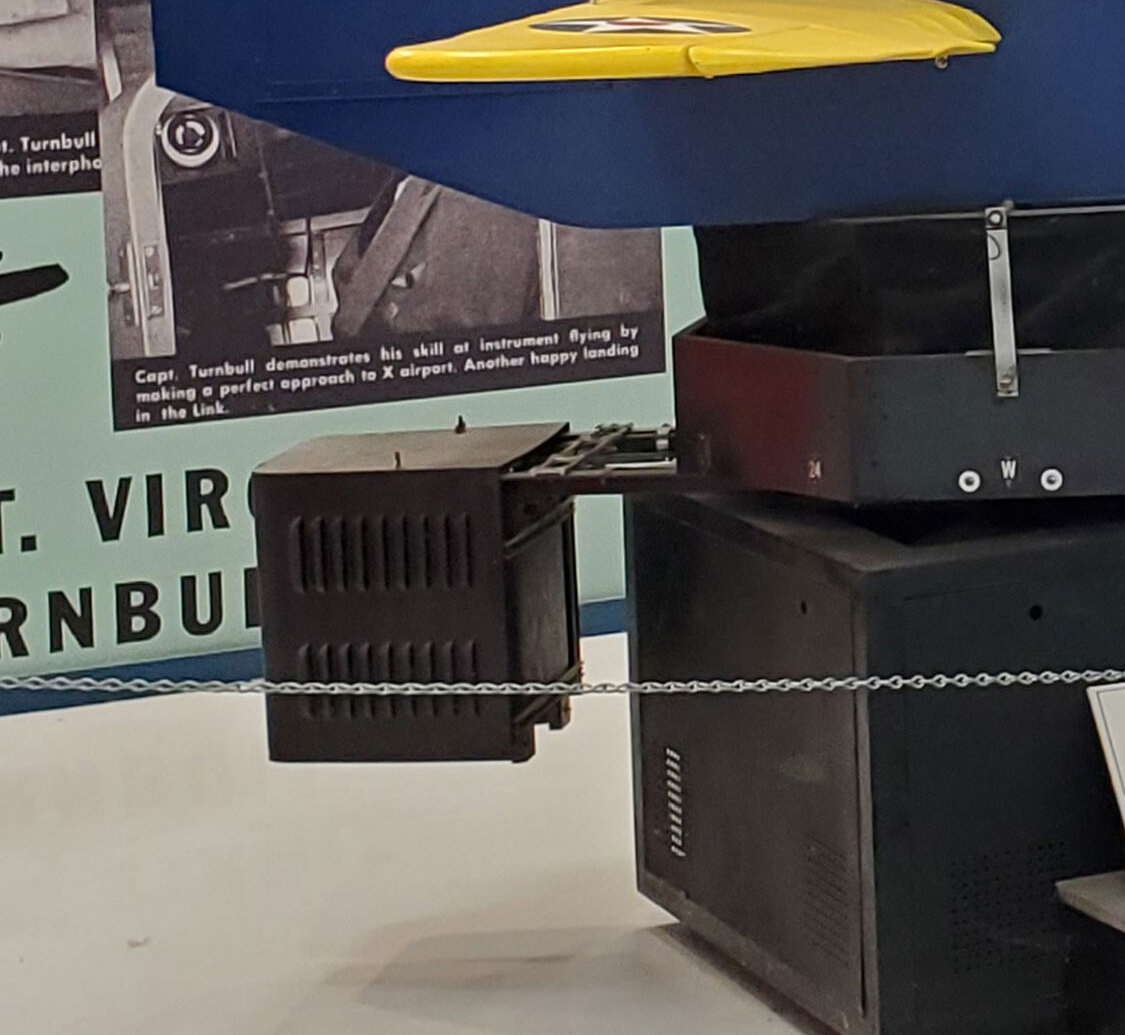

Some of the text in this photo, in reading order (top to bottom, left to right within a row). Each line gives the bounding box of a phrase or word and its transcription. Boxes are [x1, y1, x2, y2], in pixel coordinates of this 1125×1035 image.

[20, 130, 95, 152] Turnbull
[26, 154, 102, 176] interpho
[135, 324, 639, 385] Capt. Turnbull demonstrates his skill at instrument flying by
[136, 342, 639, 403] making a perfect approach to X airport. Another happy landing
[136, 409, 150, 423] in
[161, 405, 186, 420] the
[1001, 459, 1017, 481] W
[85, 468, 256, 542] VIR
